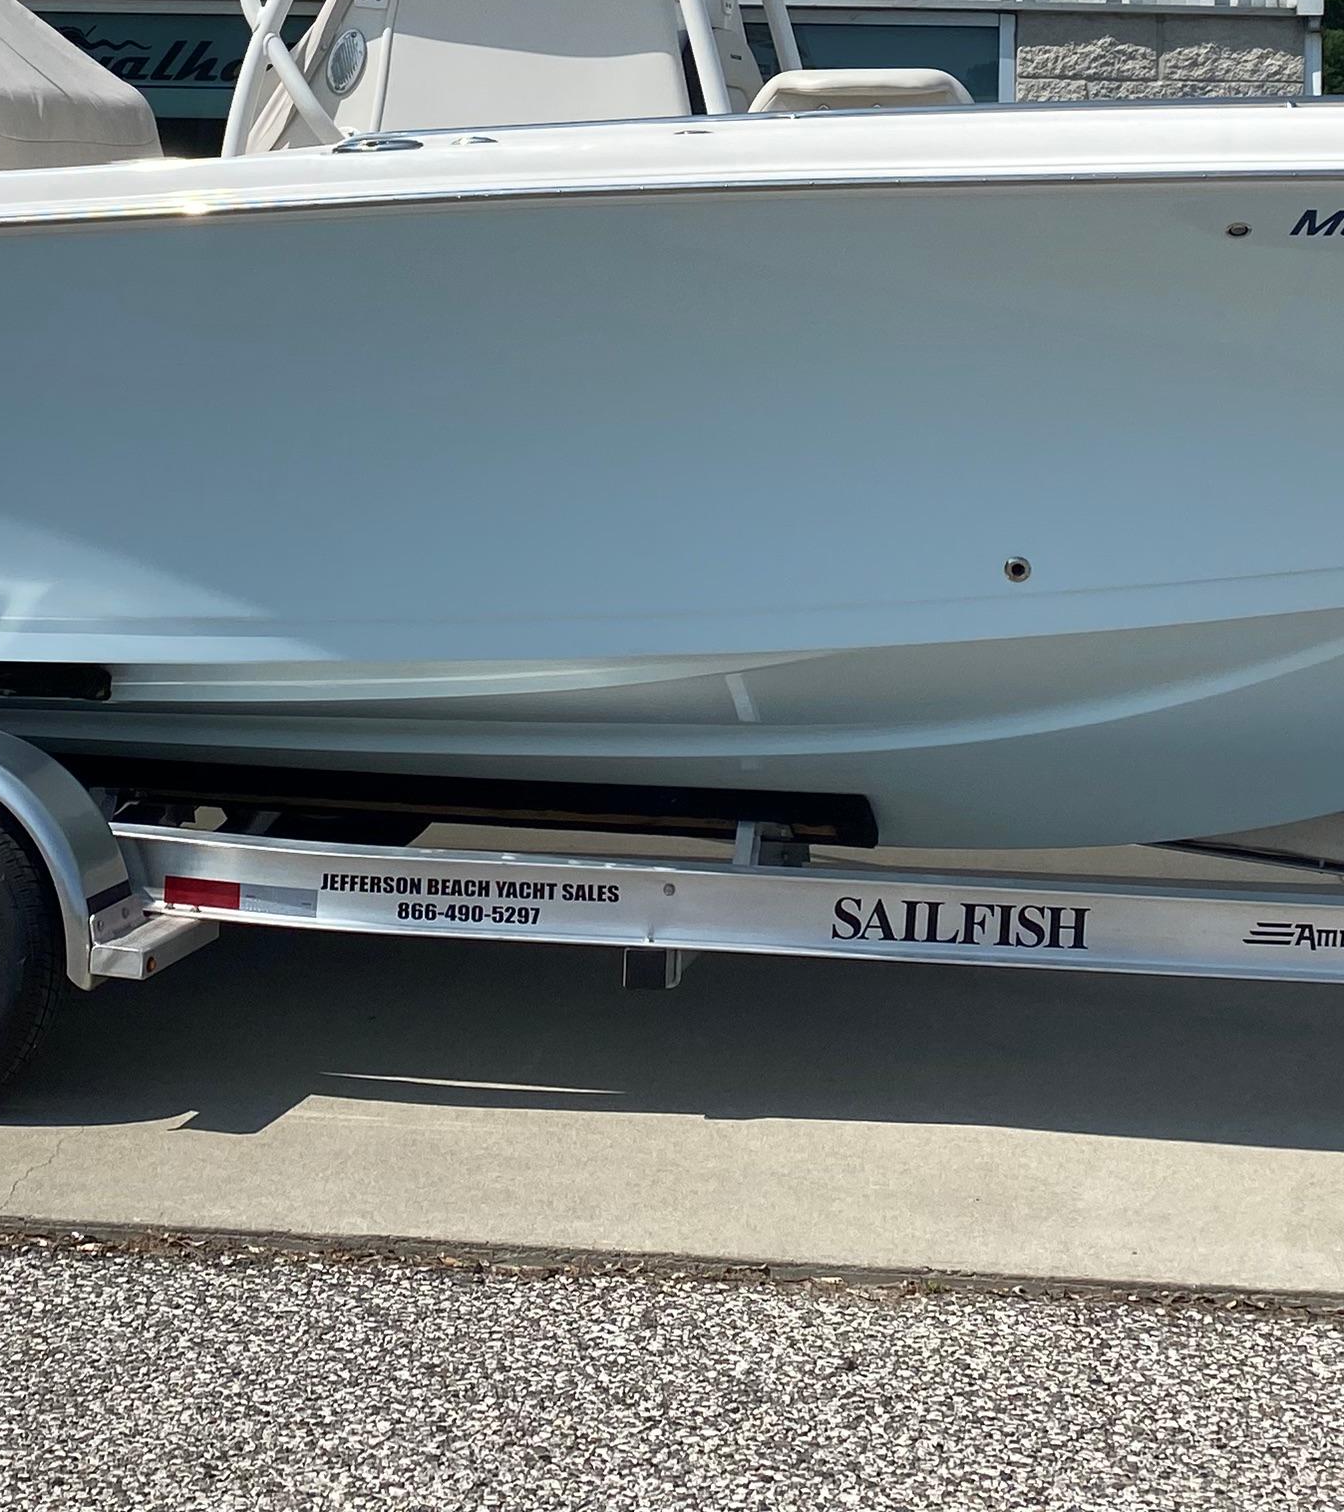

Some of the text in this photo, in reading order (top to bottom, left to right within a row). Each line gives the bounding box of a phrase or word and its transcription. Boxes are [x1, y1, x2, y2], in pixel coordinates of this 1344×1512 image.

[320, 873, 620, 903] JEFFERSON BEACH YACHT SALES
[397, 902, 540, 925] 866-490-5297
[832, 896, 1091, 950] SAILFISH
